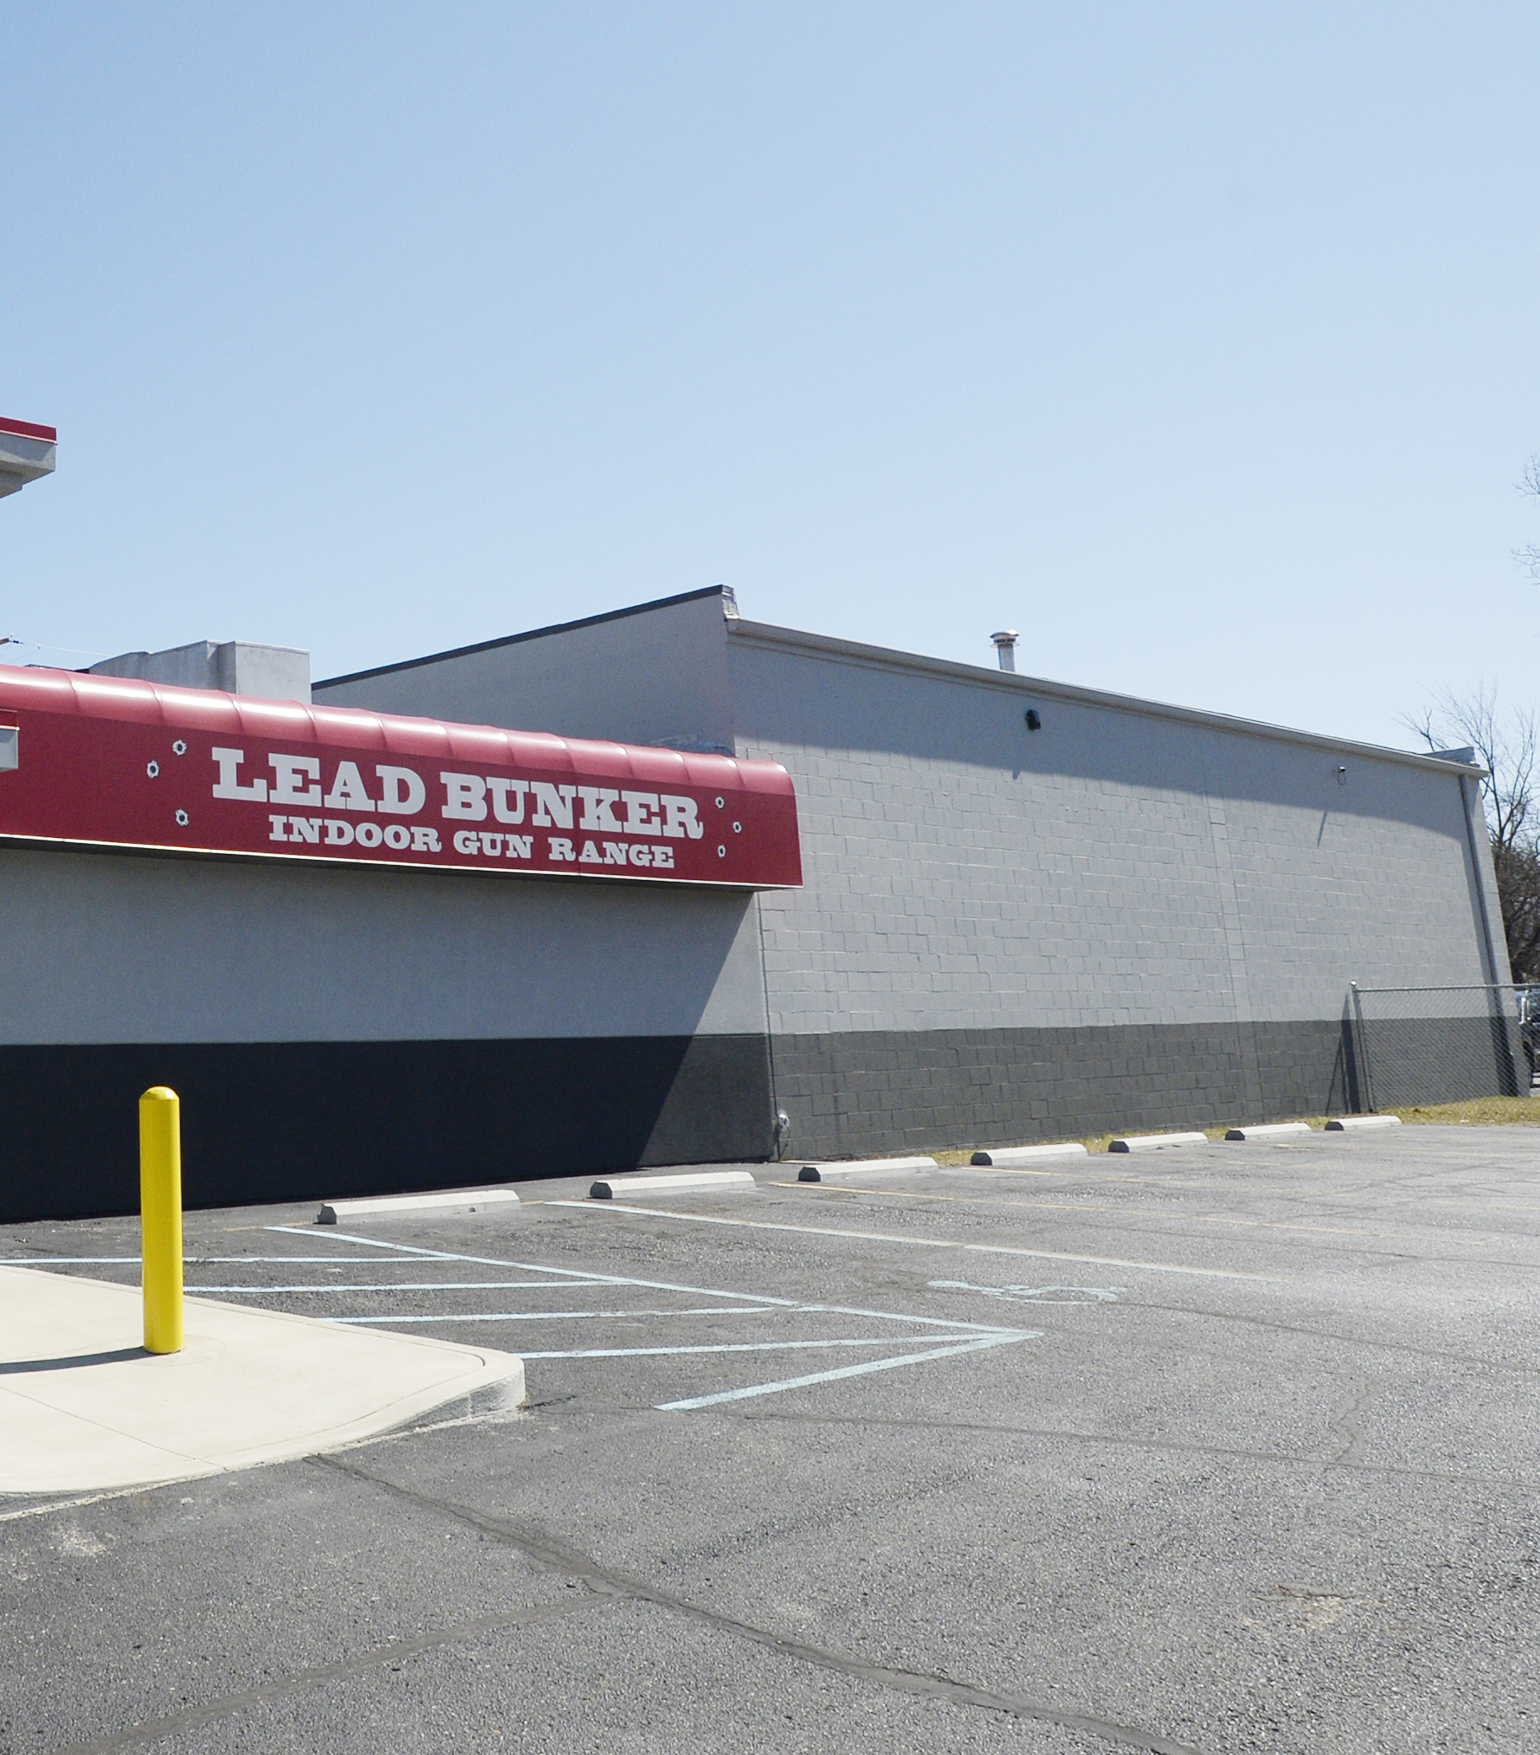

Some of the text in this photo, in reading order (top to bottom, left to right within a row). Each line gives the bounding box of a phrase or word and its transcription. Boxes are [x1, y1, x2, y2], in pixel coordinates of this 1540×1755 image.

[211, 746, 704, 839] LEAD BUNKER
[269, 814, 675, 868] INDOOR GUN RANGE
